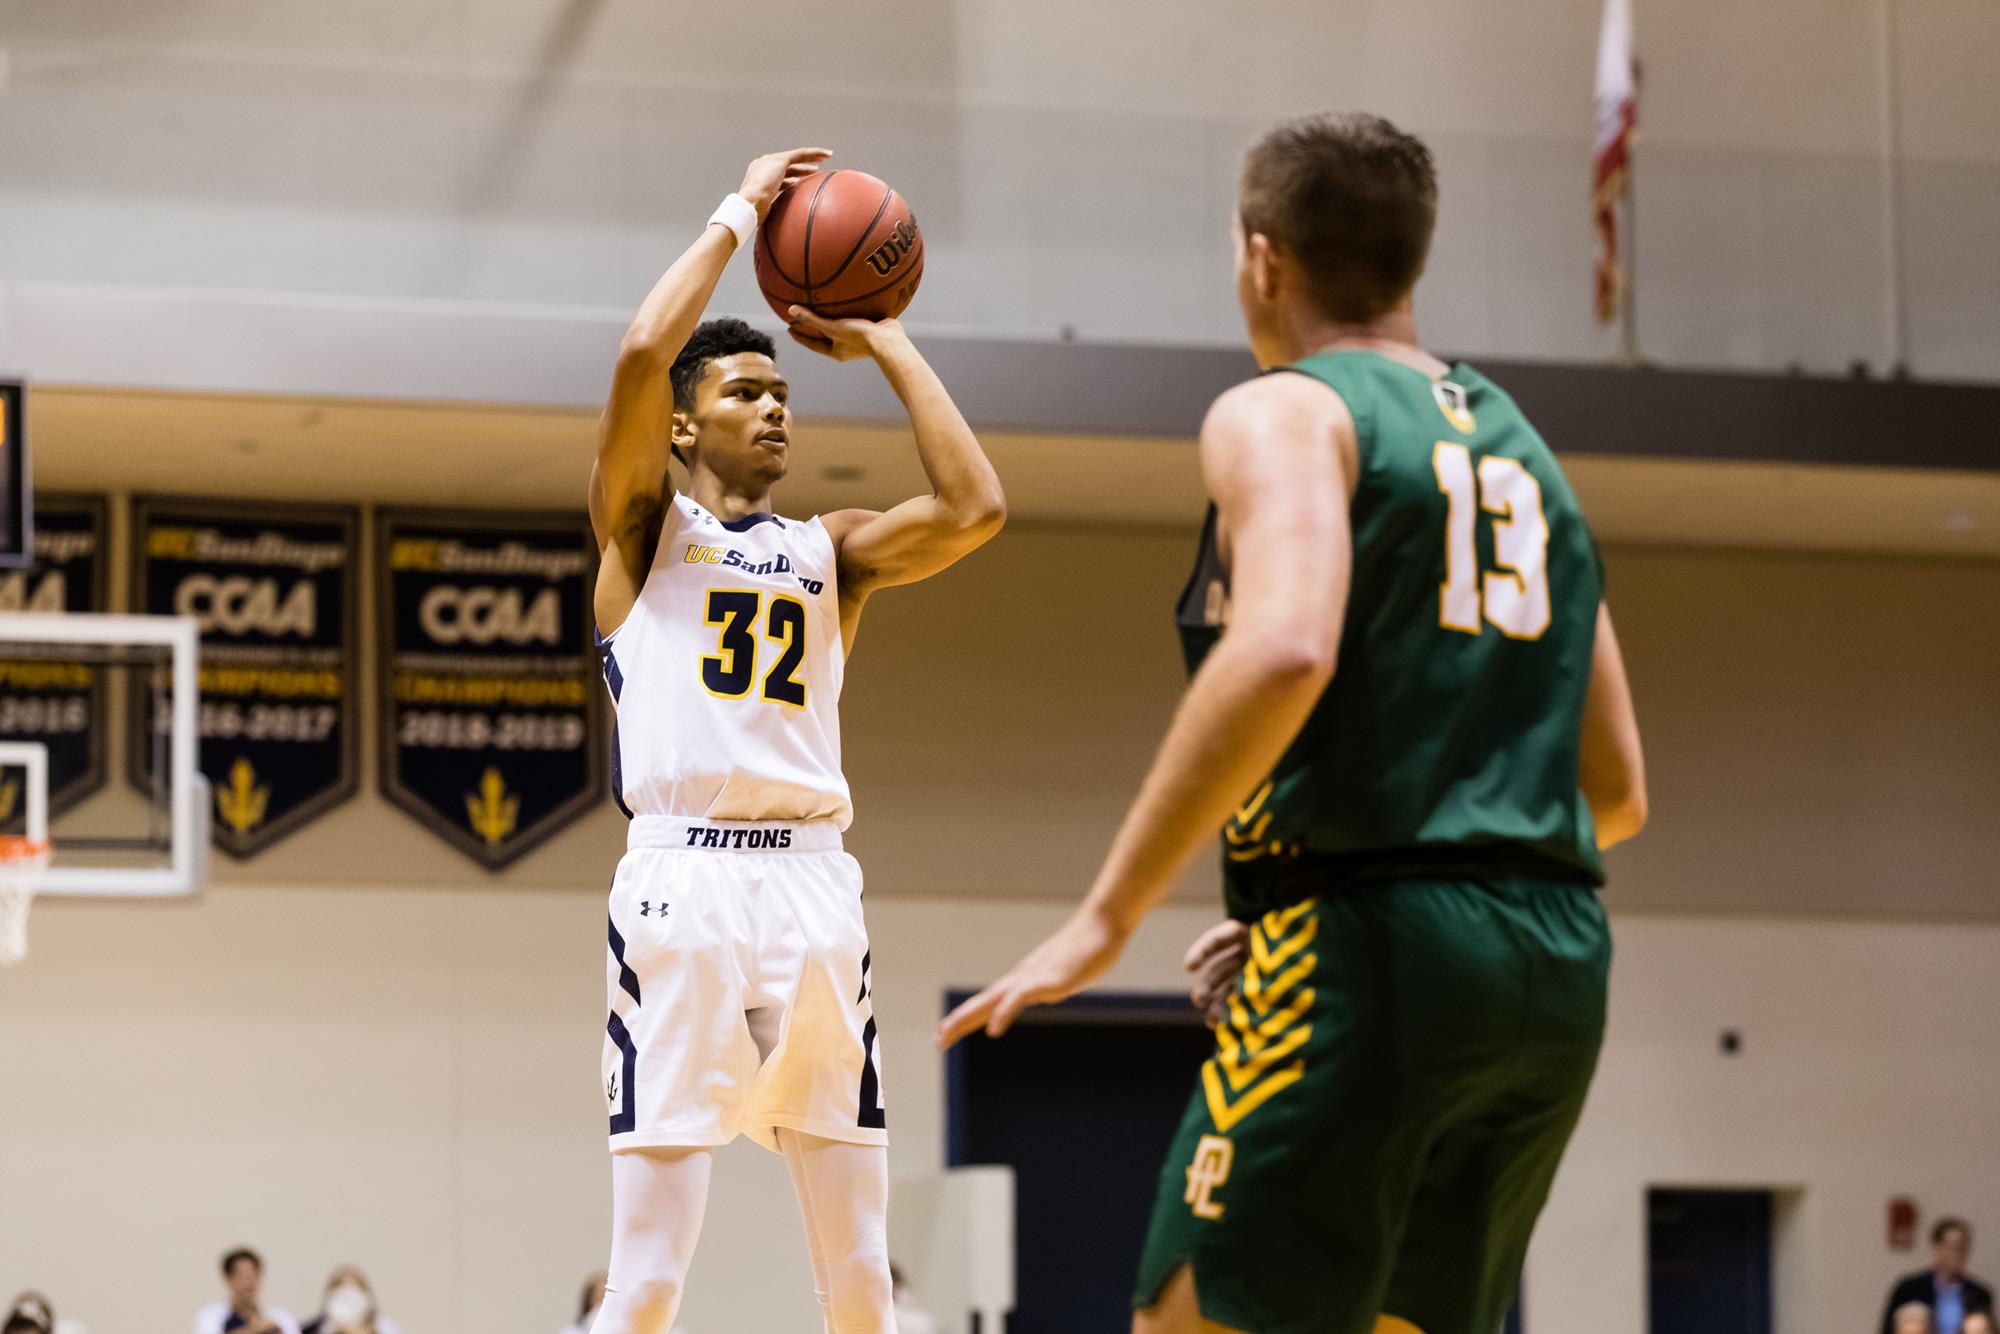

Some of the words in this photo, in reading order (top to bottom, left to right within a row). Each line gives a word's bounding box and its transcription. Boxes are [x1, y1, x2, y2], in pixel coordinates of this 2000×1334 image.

[1432, 440, 1552, 641] 13
[175, 572, 317, 637] CCAA
[419, 585, 562, 645] CCAA
[699, 588, 807, 711] 32
[686, 827, 792, 849] TRITONS
